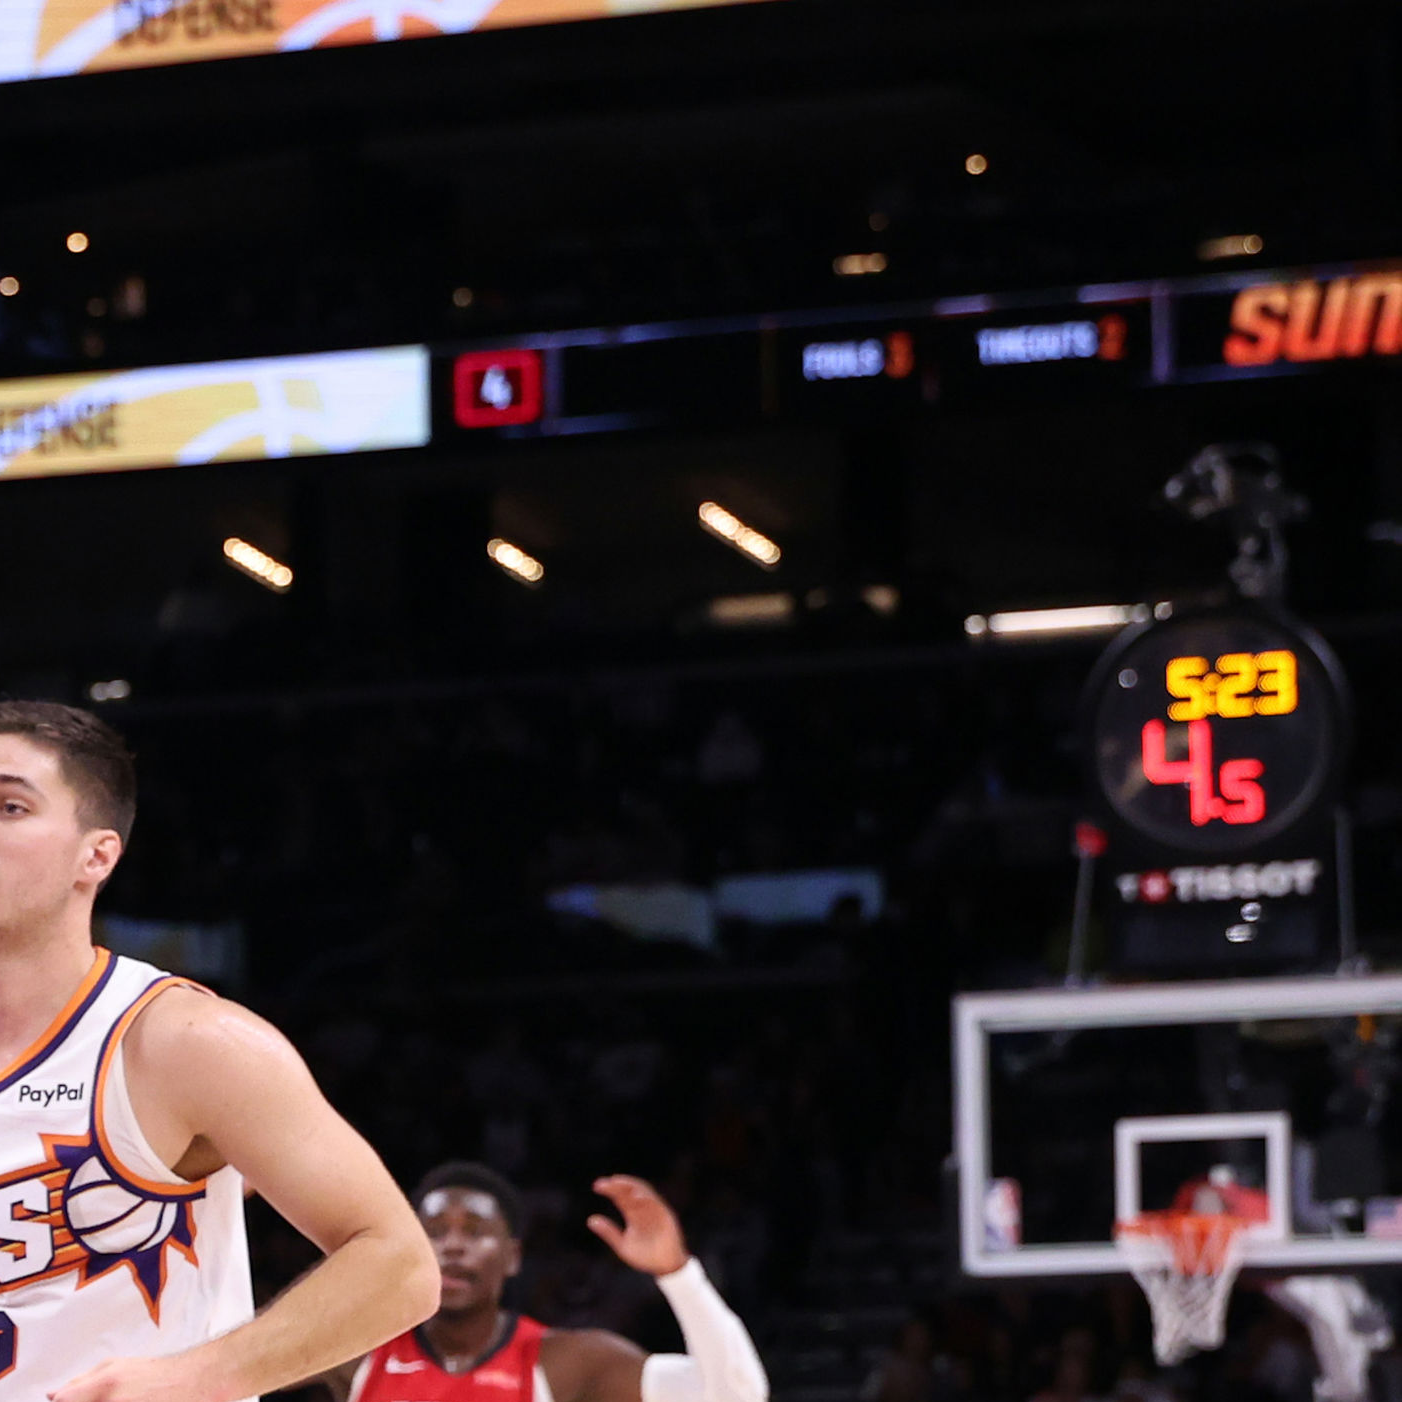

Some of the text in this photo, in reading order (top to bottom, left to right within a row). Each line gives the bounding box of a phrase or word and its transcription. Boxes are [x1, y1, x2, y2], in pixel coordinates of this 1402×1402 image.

[1165, 649, 1299, 723] 5:23
[1141, 717, 1267, 828] 4.5
[19, 1083, 84, 1108] PayPal
